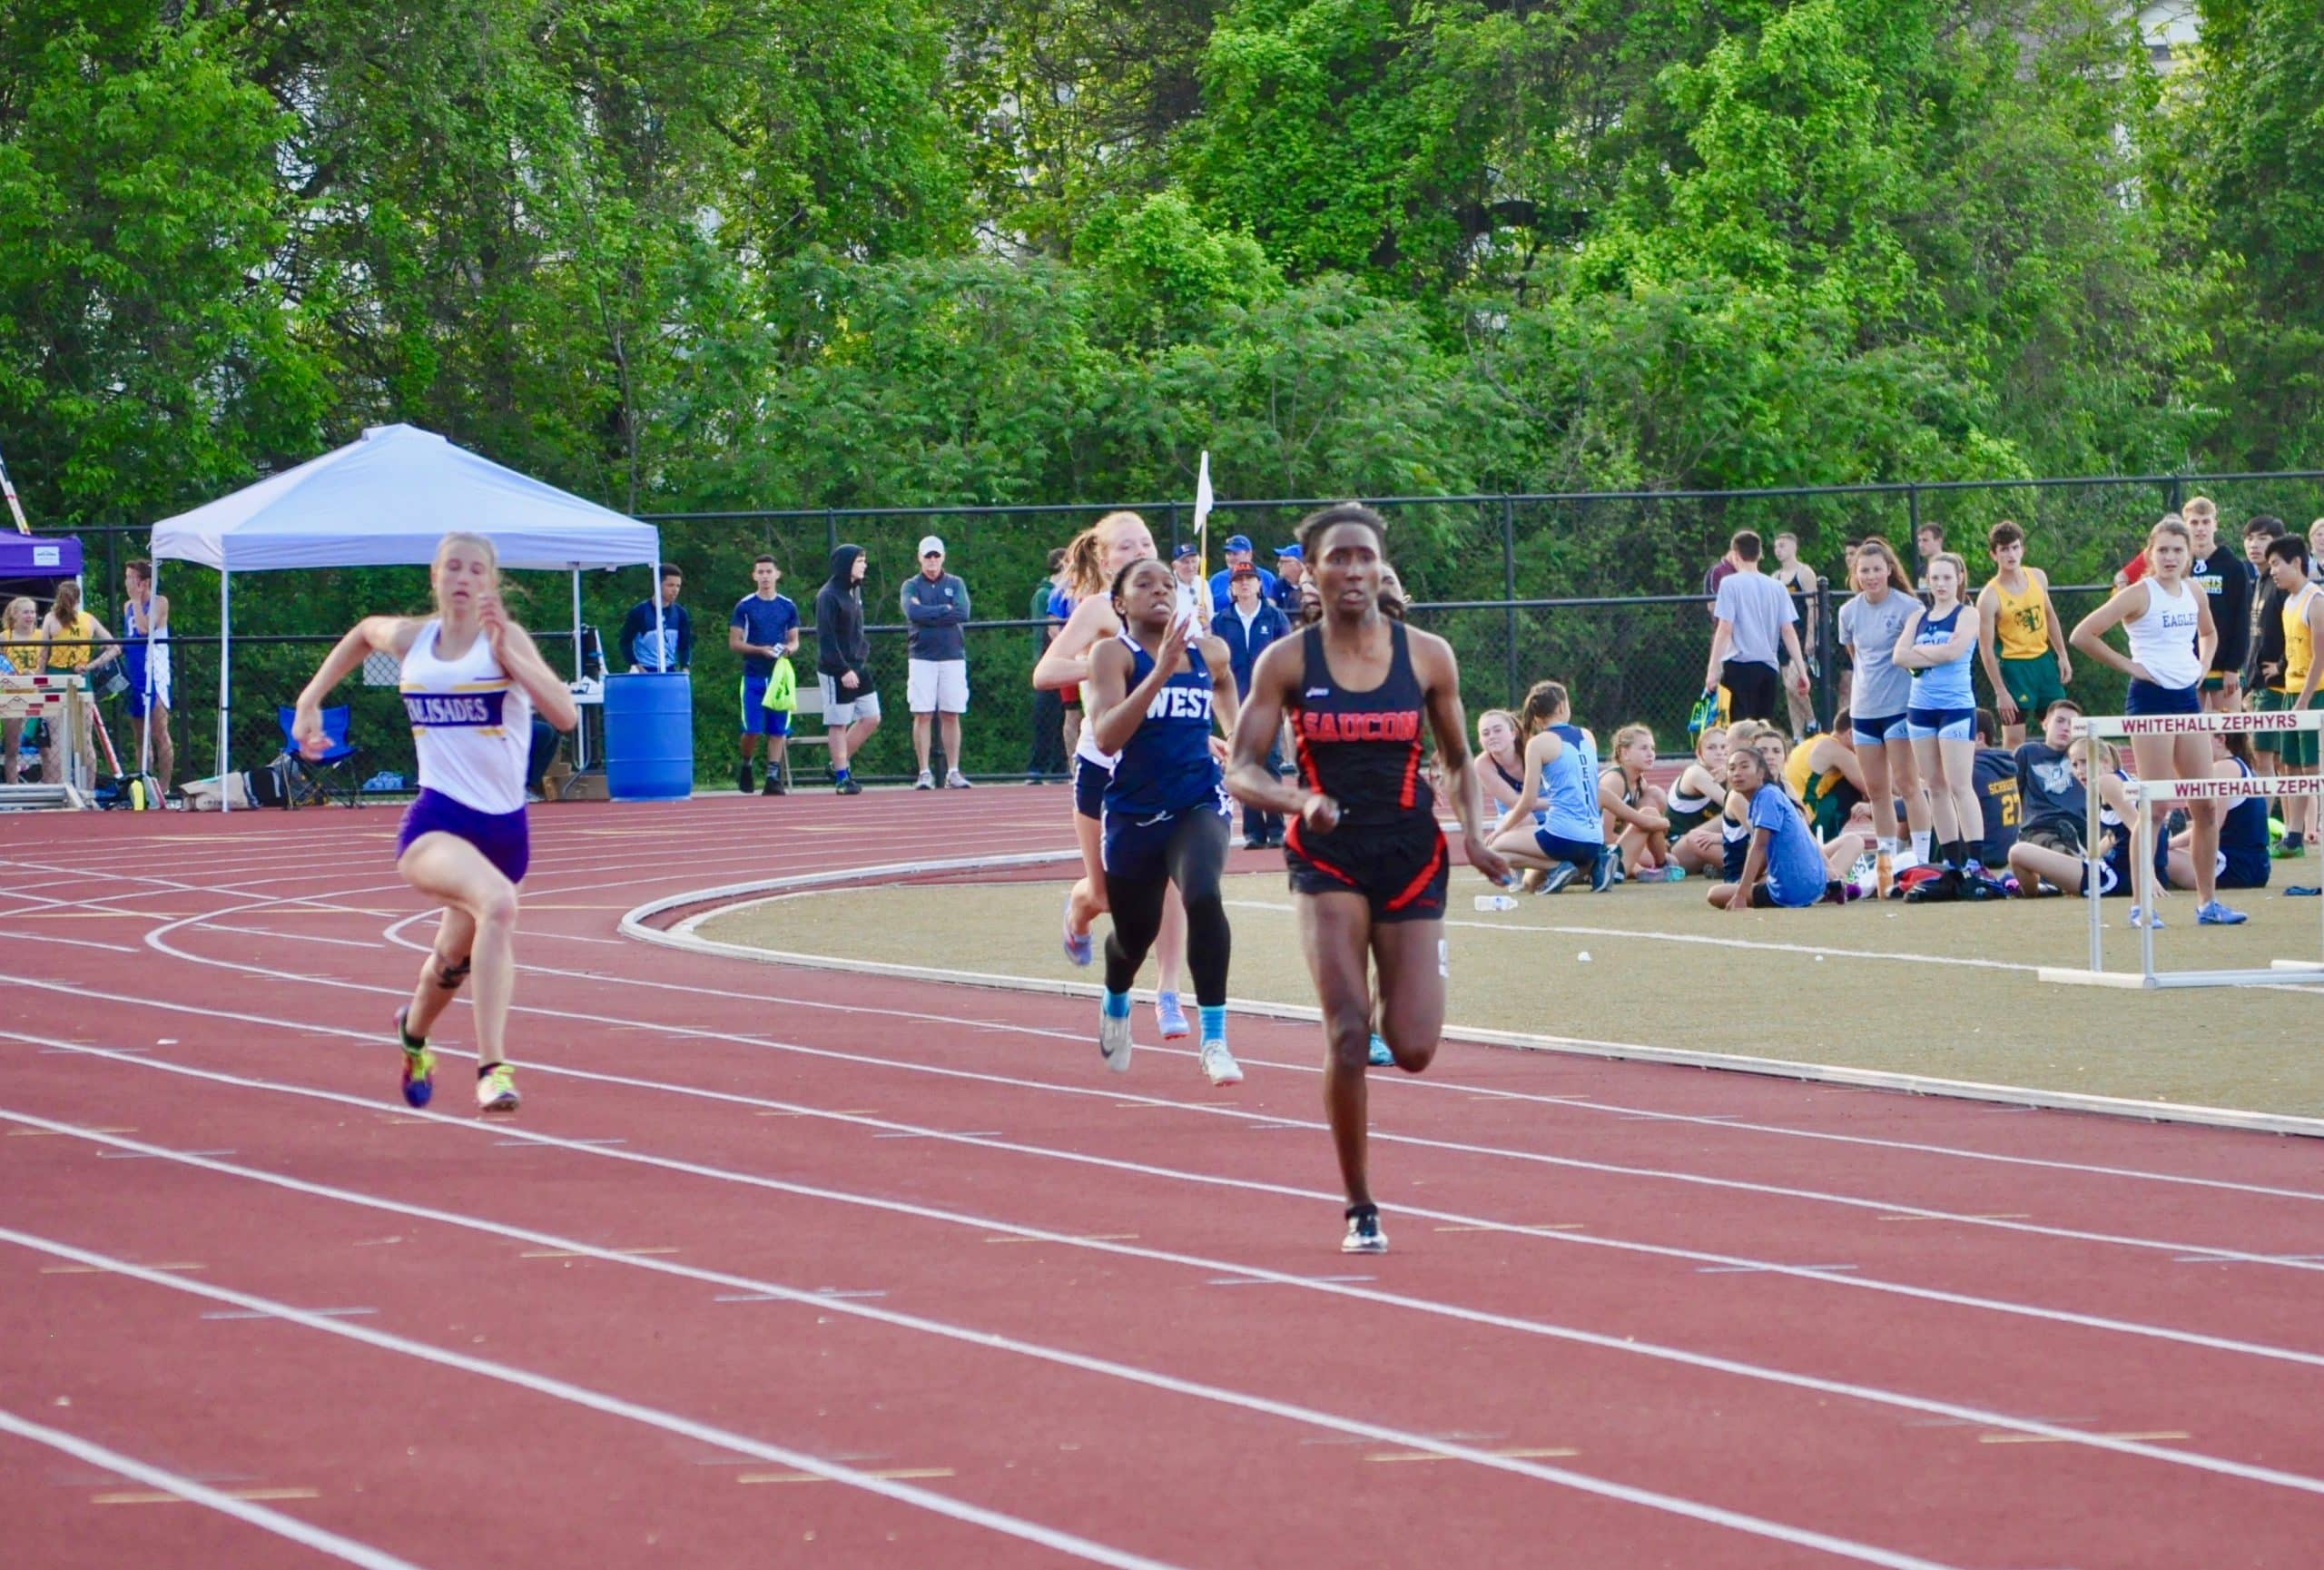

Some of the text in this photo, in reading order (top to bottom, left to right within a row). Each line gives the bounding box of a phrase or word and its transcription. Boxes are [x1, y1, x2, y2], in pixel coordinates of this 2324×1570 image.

[403, 696, 489, 723] ALISADES
[1147, 686, 1214, 720] WEST
[1304, 711, 1418, 741] SAUCON
[2122, 715, 2297, 734] WHITEHALL ZEPHYRS
[2174, 781, 2271, 797] WHITEHALL
